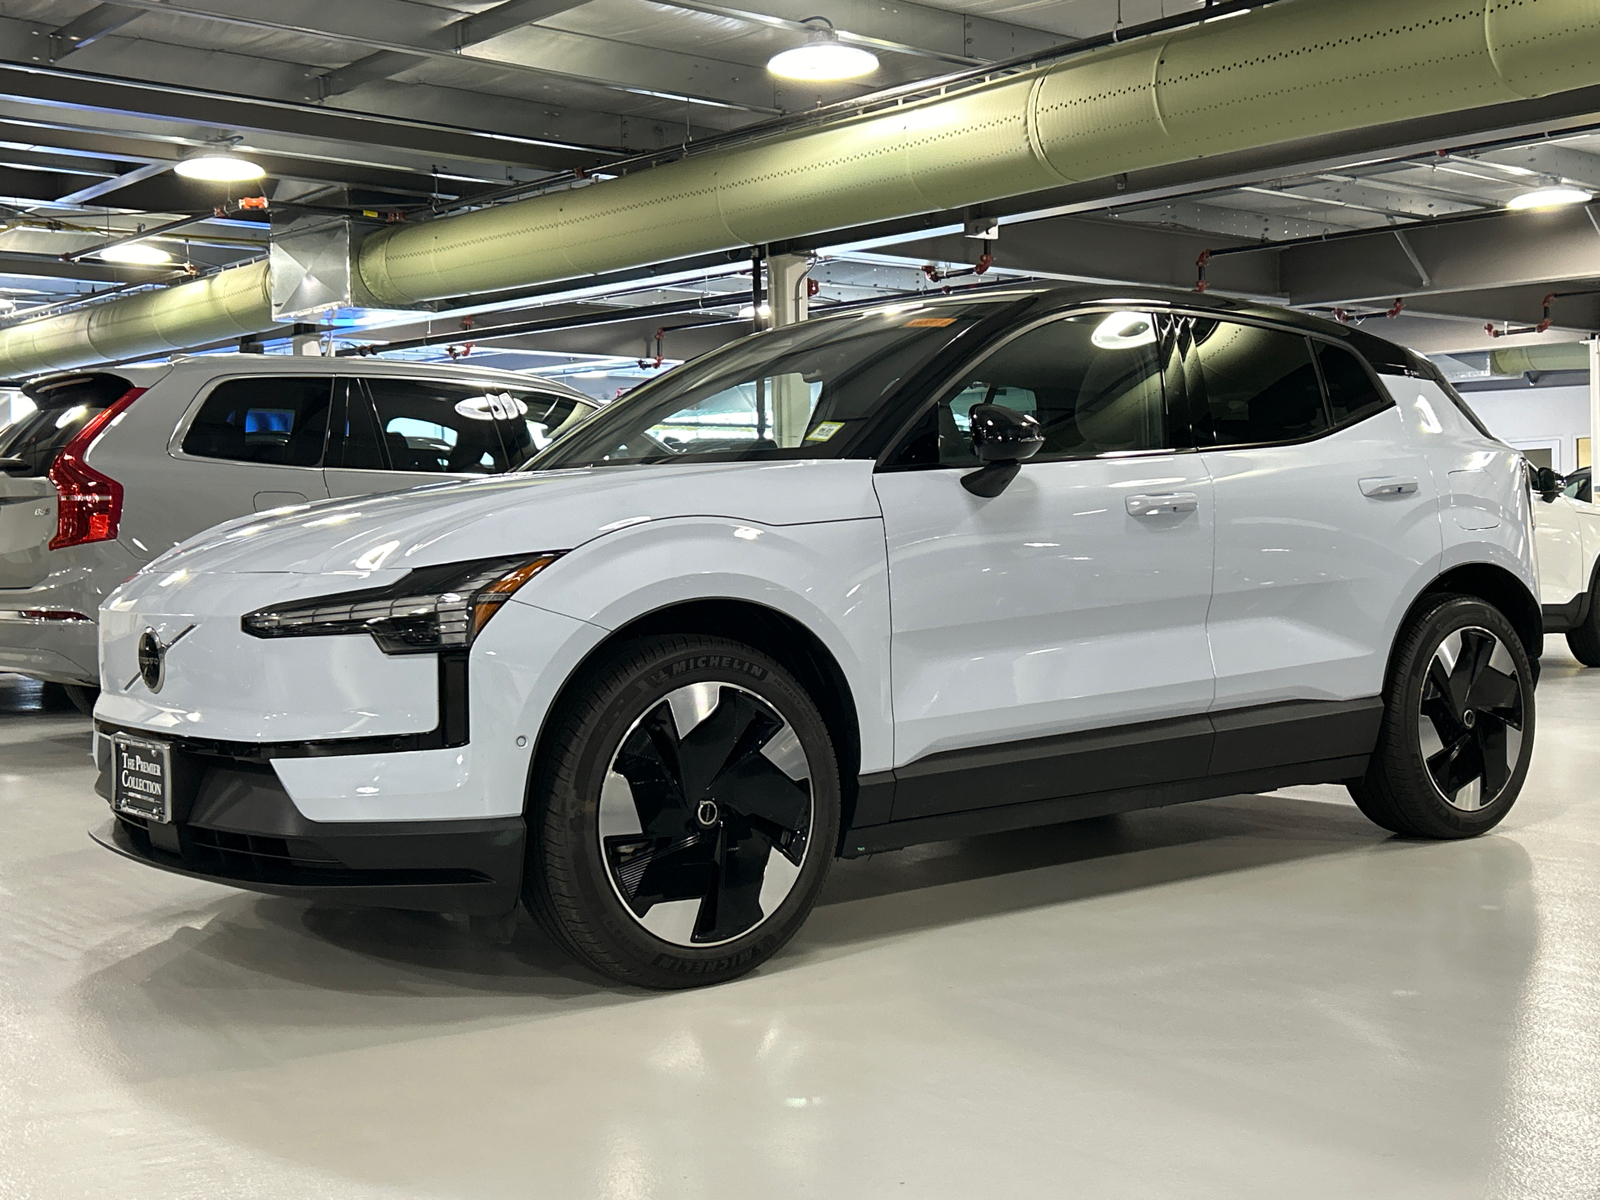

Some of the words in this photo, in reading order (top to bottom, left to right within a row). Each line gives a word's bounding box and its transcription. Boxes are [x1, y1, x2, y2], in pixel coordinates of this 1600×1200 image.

[672, 656, 764, 678] MICHELIN
[122, 752, 136, 771] THE
[135, 755, 162, 776] PREMIER
[122, 770, 162, 795] COLLECTION
[657, 948, 754, 973] MICHELIN
